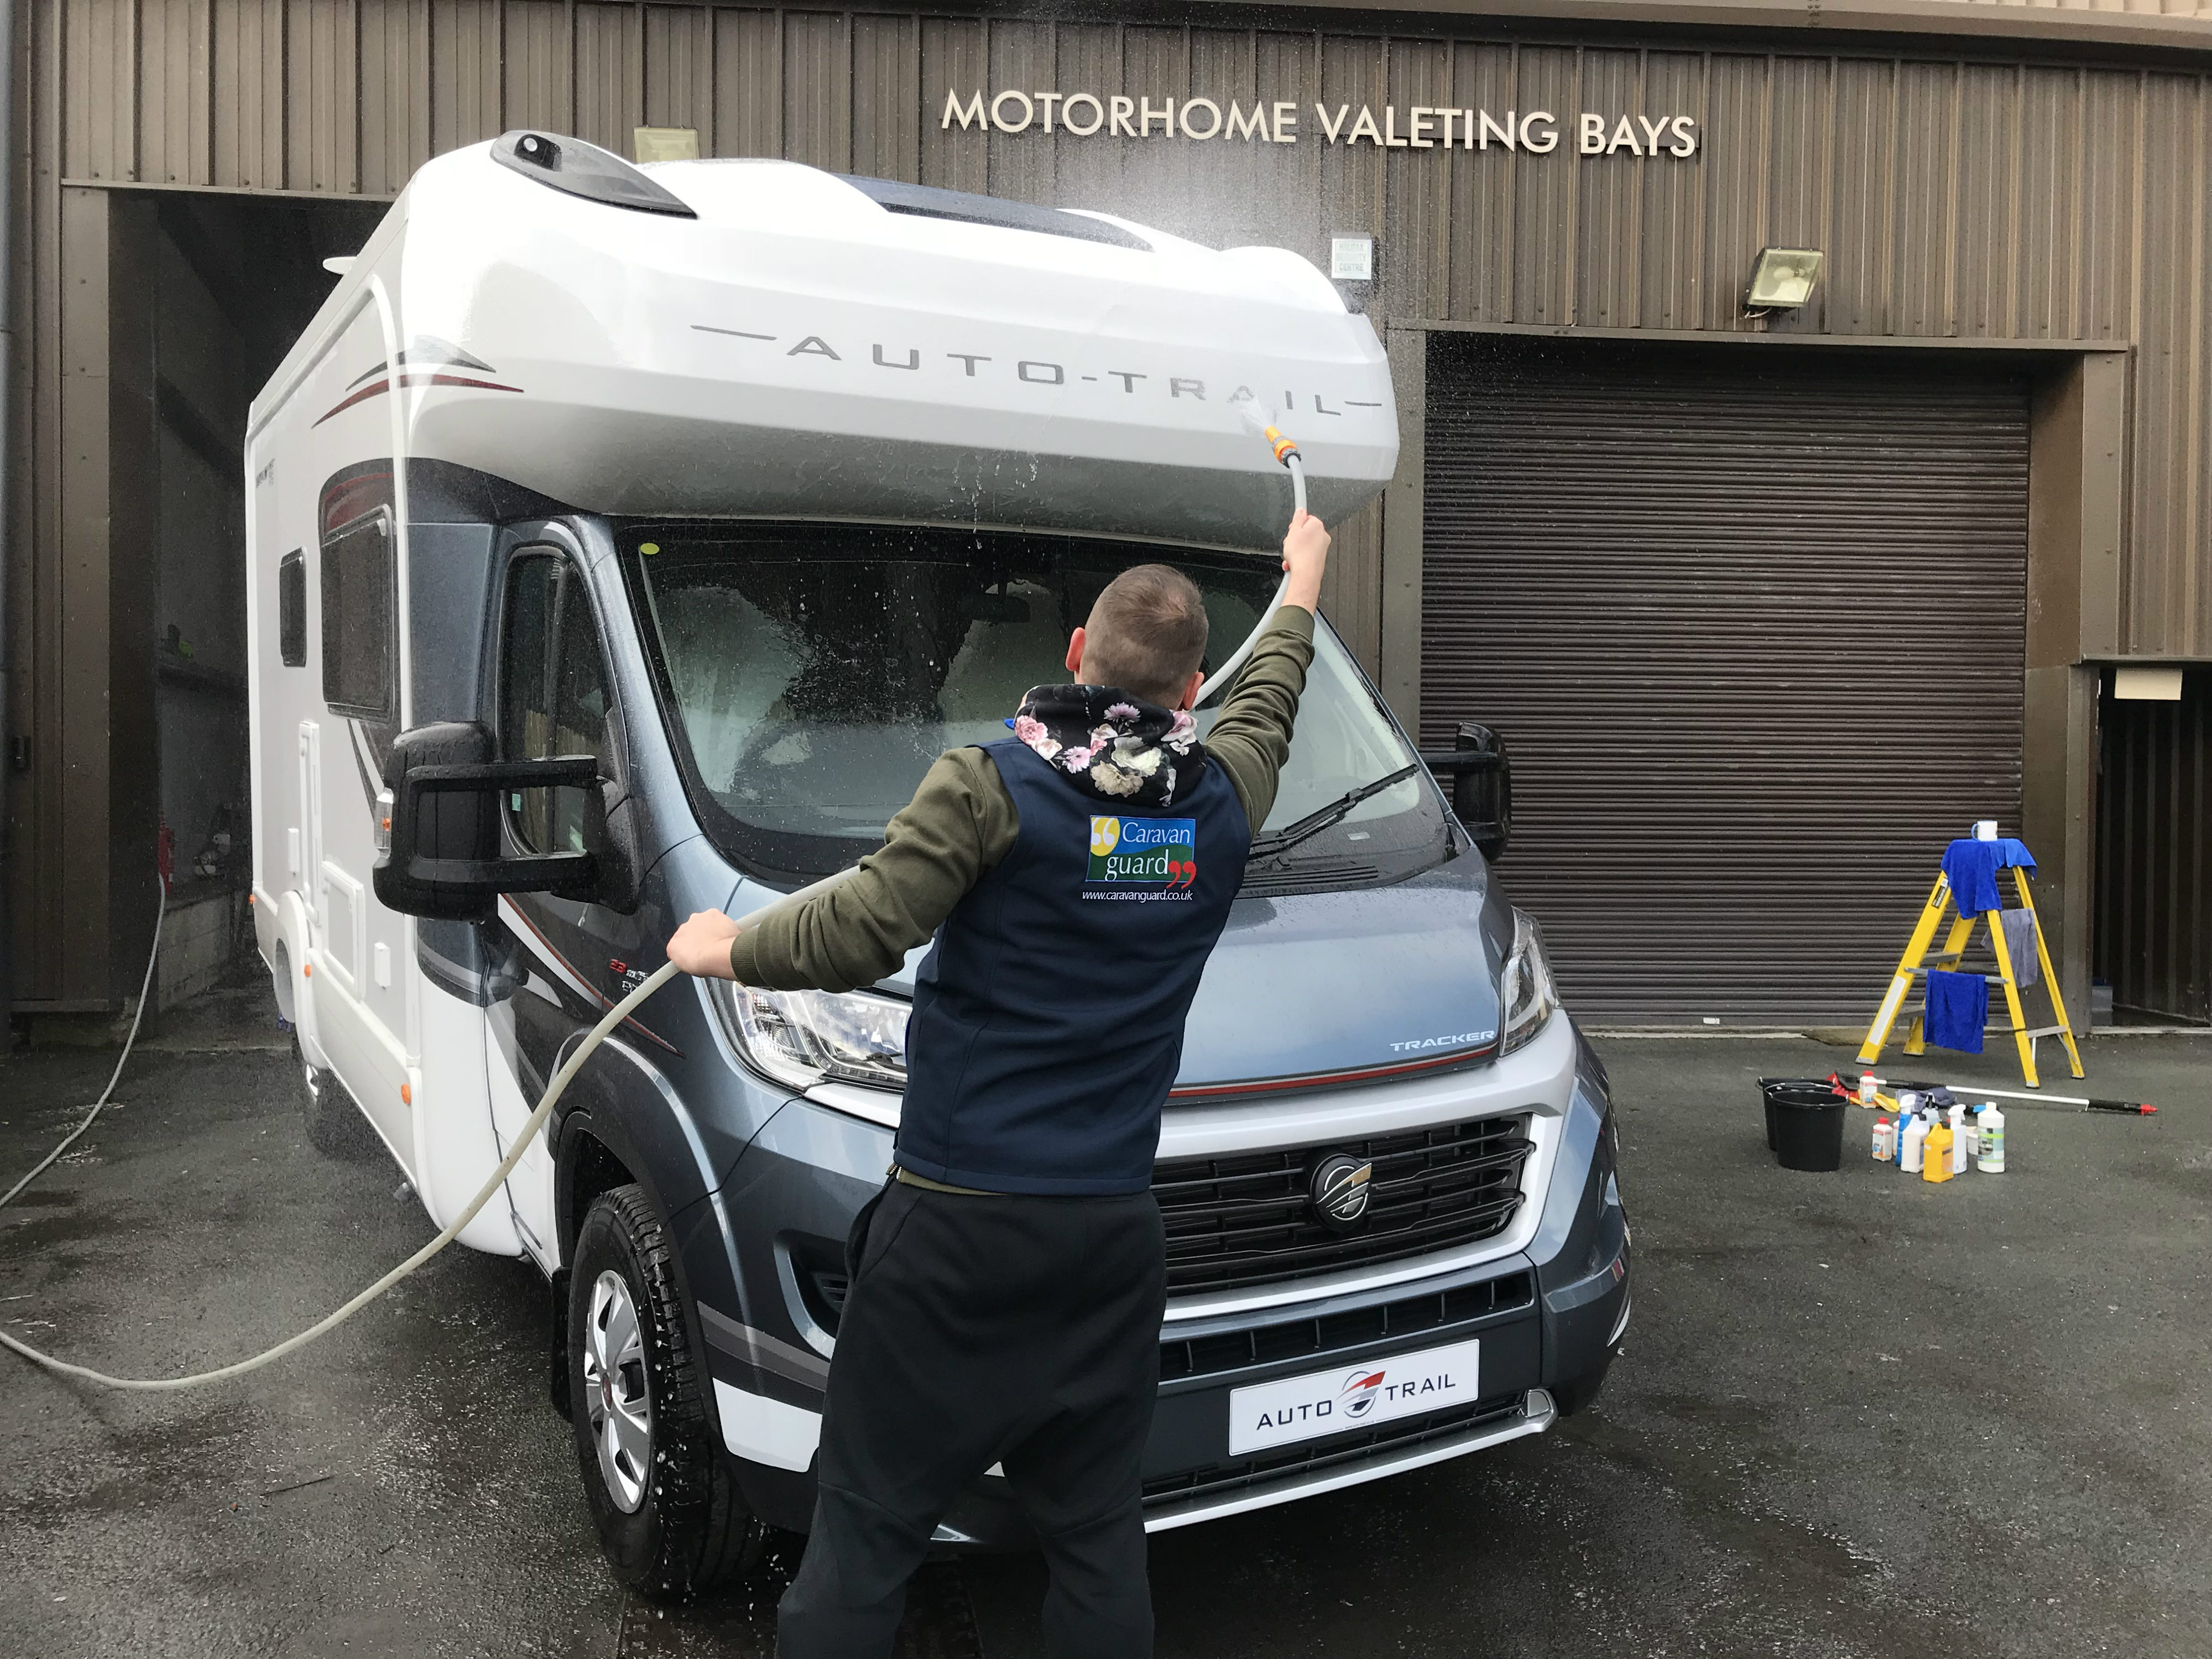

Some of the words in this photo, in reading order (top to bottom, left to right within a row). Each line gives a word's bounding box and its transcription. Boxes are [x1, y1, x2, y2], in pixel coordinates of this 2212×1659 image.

[941, 89, 1297, 143] MOTORHOME
[1316, 103, 1558, 154] VALETING
[1580, 114, 1696, 158] BAYS
[1122, 822, 1190, 844] Caravan
[1104, 849, 1168, 881] guard
[1082, 889, 1193, 903] www.caravanguard.co.uk
[1390, 1030, 1494, 1051] TRACKER
[1256, 1400, 1332, 1430] AUTO
[1385, 1374, 1455, 1401] TRAIL
